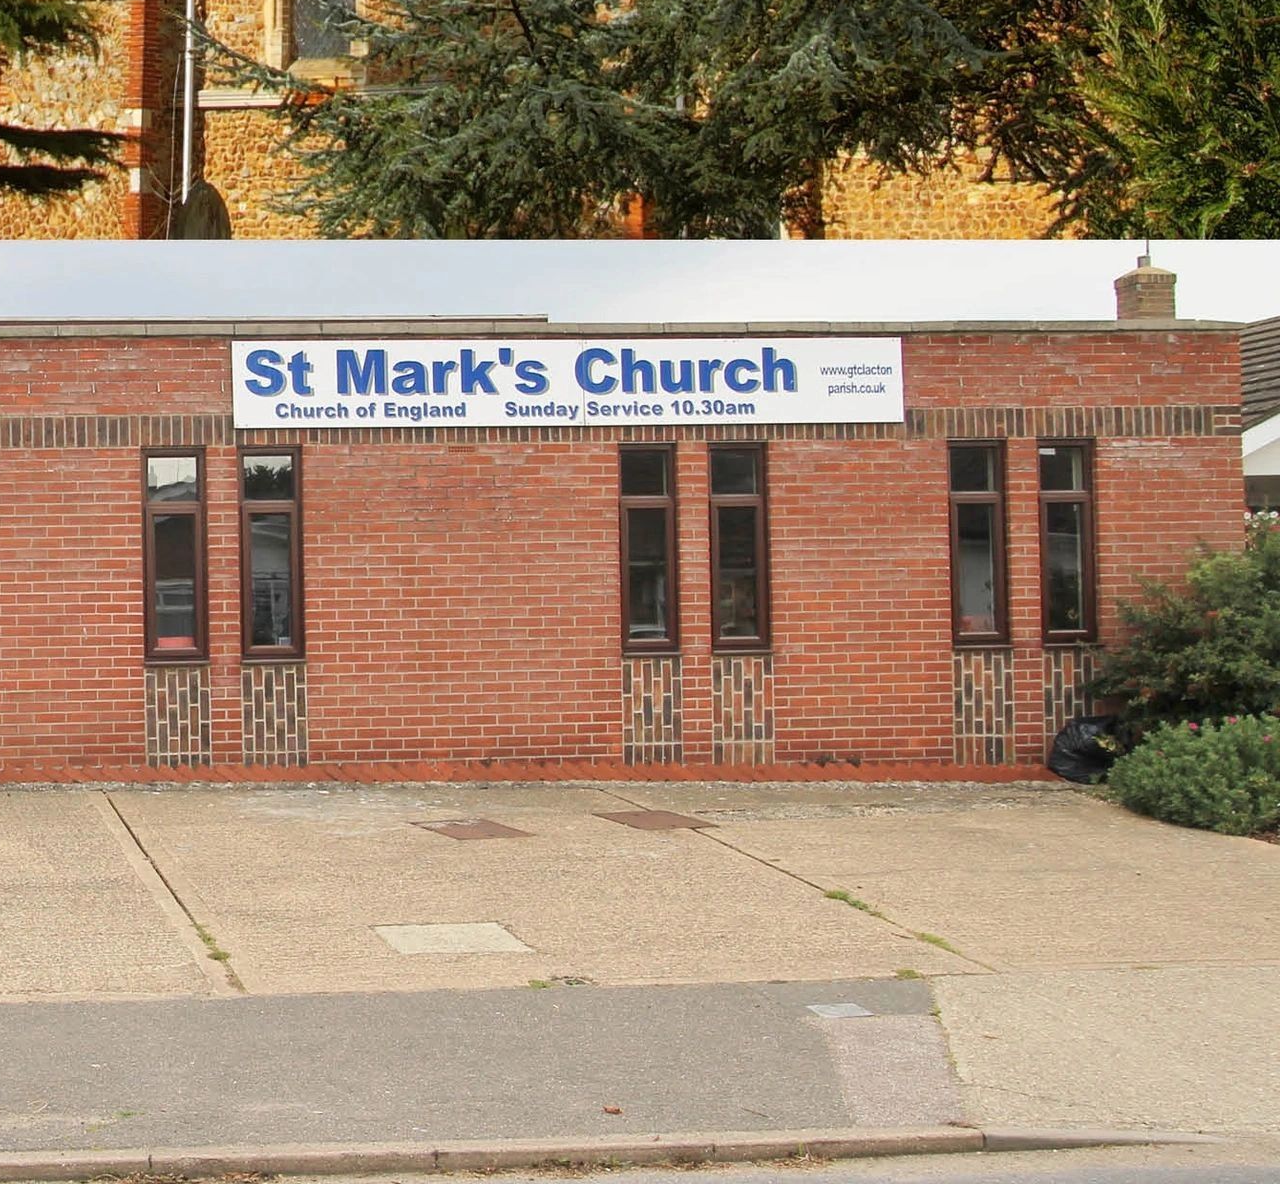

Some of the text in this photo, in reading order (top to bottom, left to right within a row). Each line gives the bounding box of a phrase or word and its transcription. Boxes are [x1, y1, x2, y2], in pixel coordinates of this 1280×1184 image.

[244, 347, 798, 397] St Mark's Church
[820, 363, 893, 378] www.gtclacton
[828, 382, 886, 396] parish.co.uk
[275, 399, 756, 423] Church of England Sunday Service 10.30am
